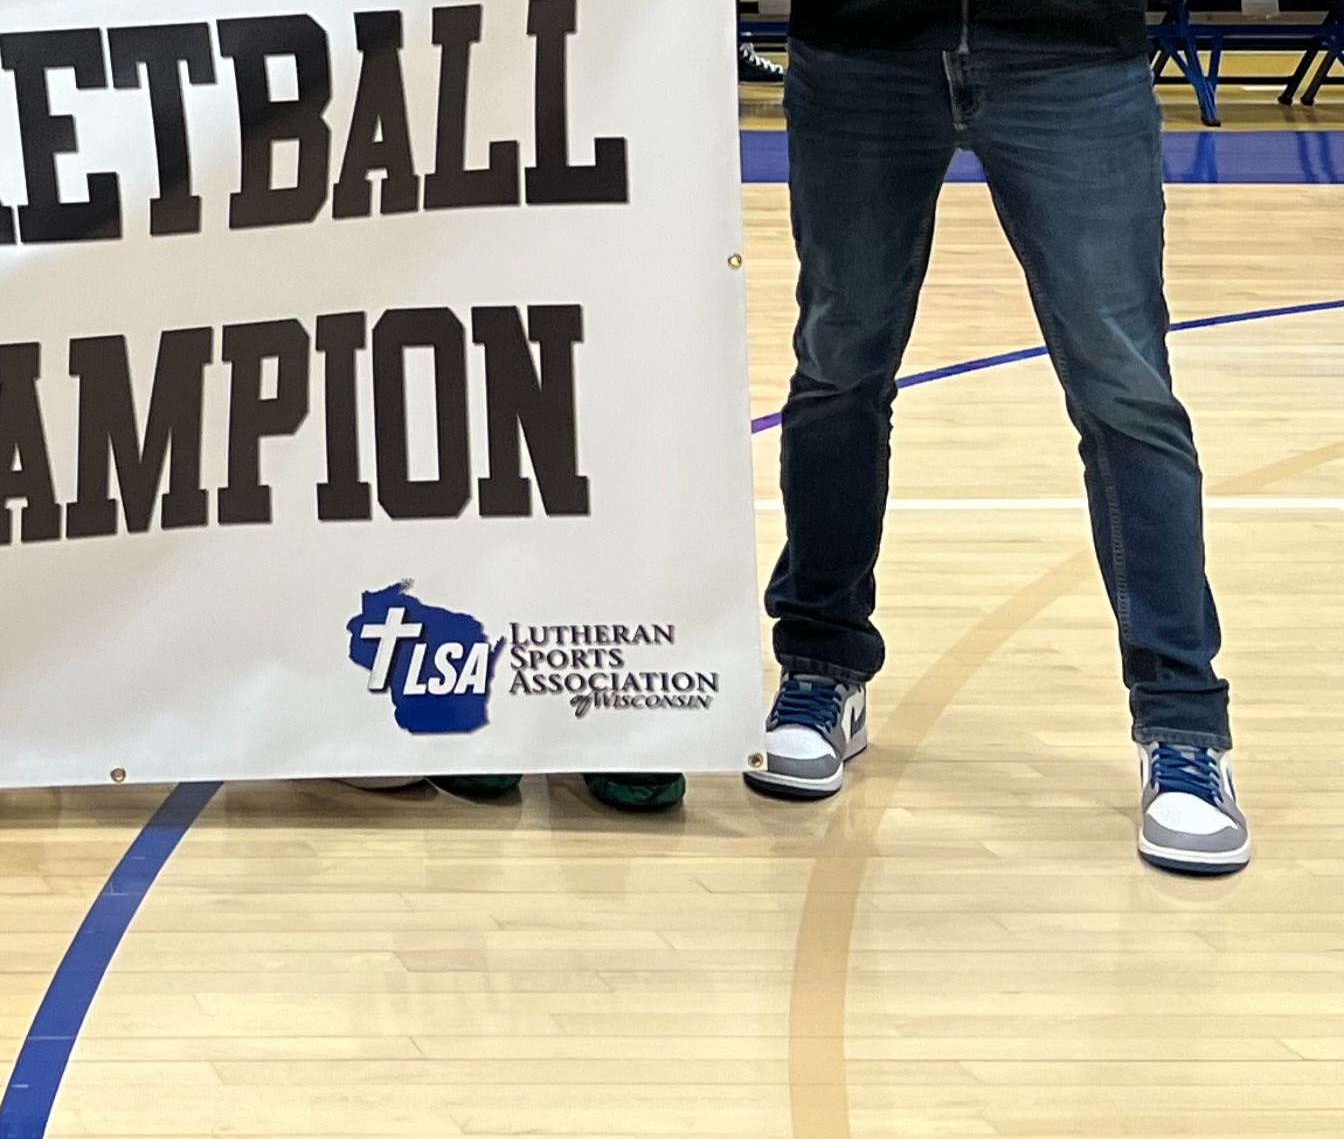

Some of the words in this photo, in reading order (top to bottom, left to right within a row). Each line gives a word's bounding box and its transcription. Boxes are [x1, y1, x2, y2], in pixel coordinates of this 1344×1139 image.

[509, 622, 676, 646] LUTHERAN
[402, 642, 489, 696] LSA
[509, 643, 625, 671] SPORTS
[508, 668, 721, 696] ASSOCIATION
[591, 690, 714, 711] WISCONSIN
